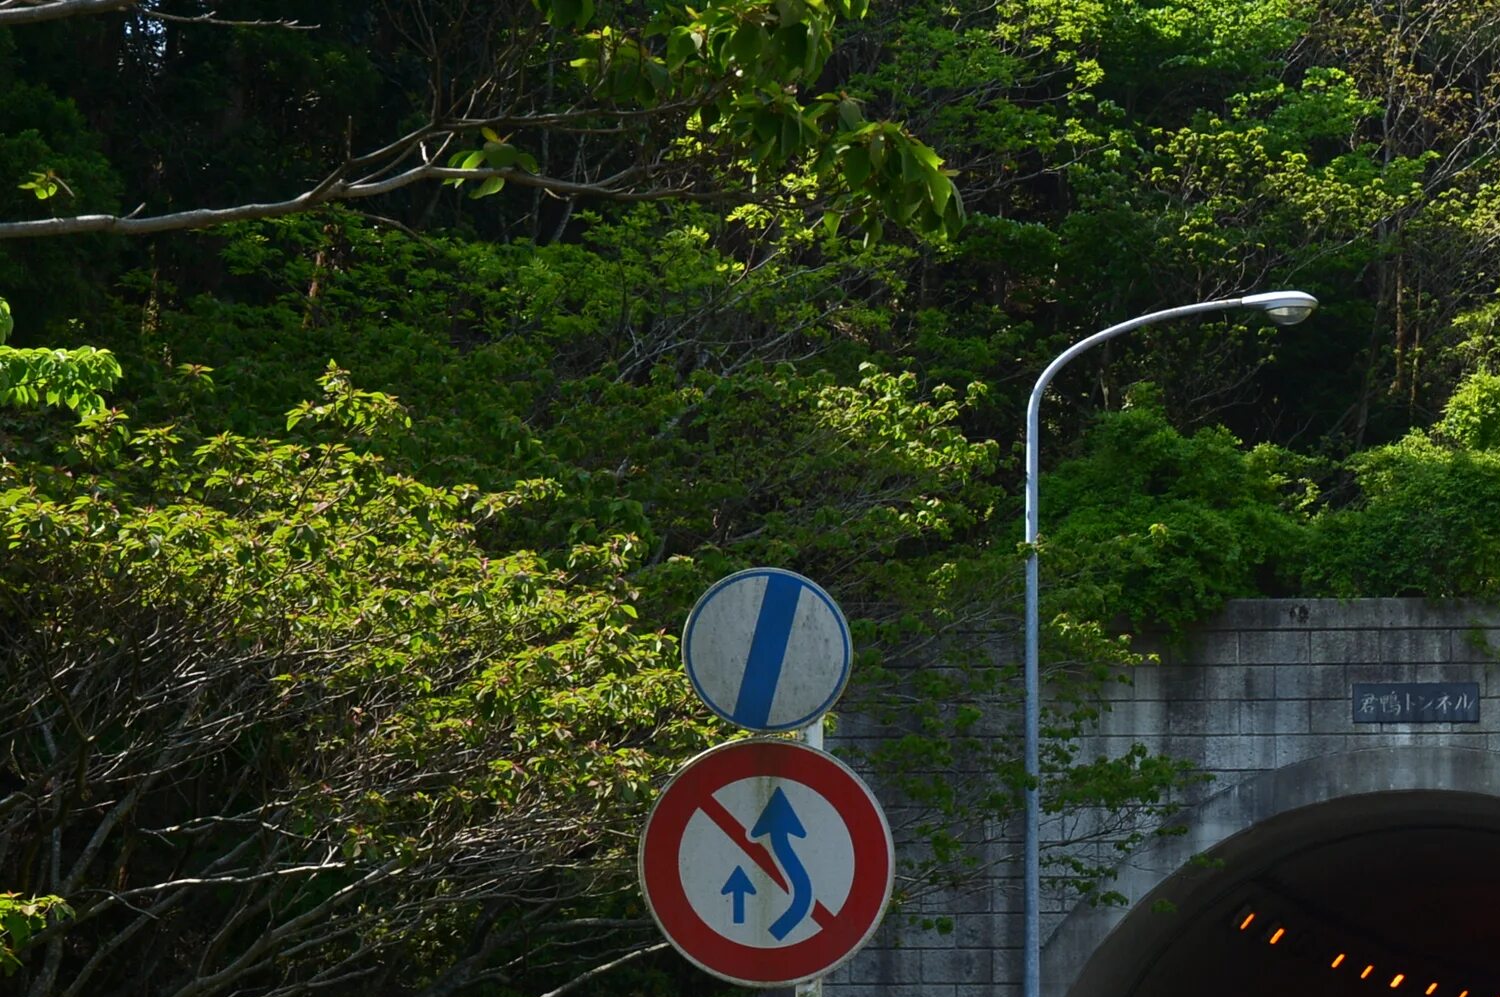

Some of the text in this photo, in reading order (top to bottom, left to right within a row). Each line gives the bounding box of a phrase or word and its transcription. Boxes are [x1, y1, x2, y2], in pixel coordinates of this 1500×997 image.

[1359, 691, 1474, 716] 君鴨トンネル
